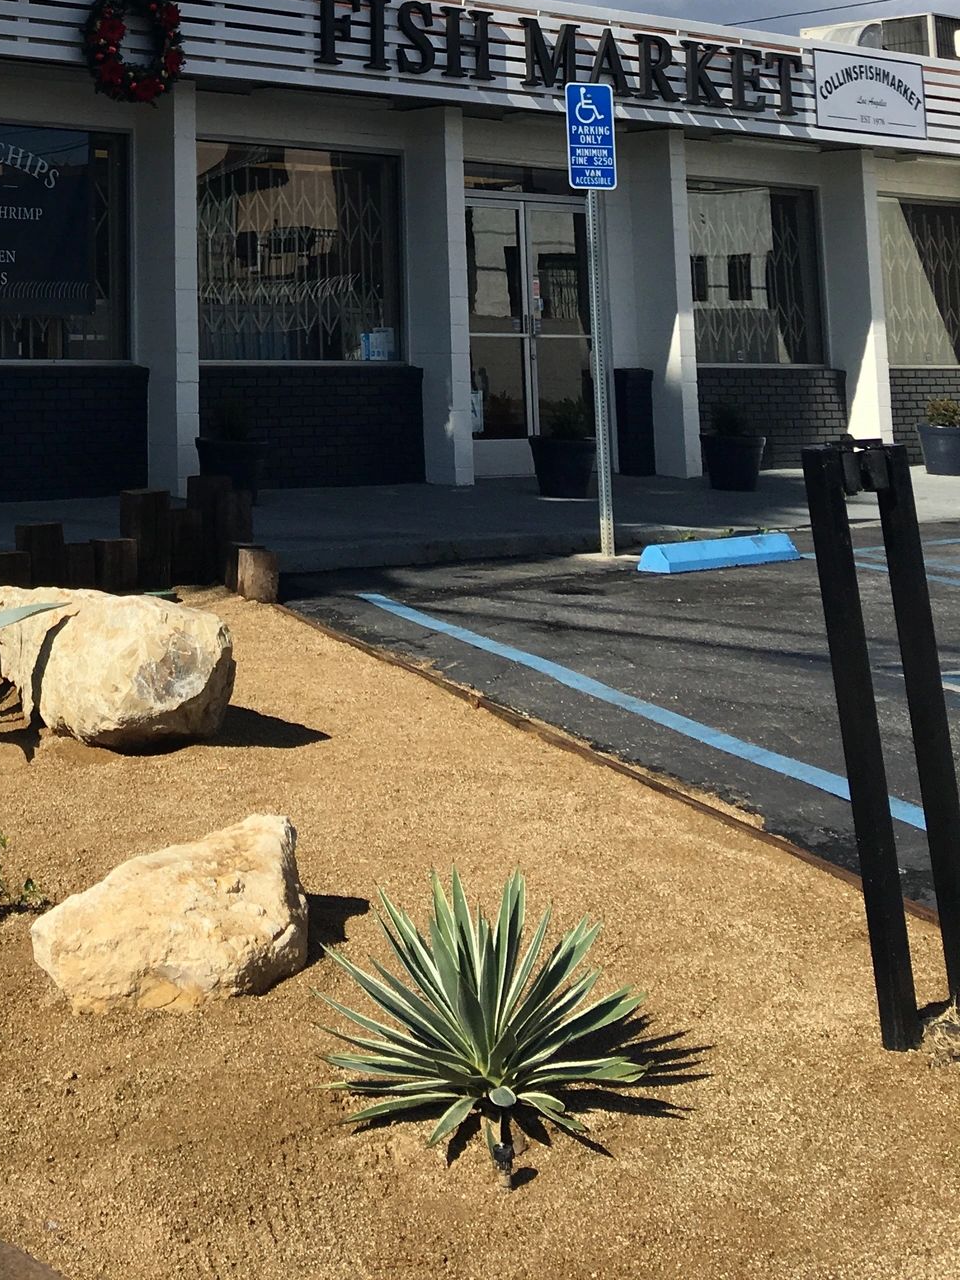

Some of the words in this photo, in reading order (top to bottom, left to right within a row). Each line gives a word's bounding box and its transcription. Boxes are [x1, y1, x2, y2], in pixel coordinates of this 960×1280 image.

[518, 17, 803, 116] MARKET
[820, 65, 922, 111] COLLINSFISHMARKET
[572, 125, 610, 135] PARKING
[580, 135, 602, 144] ONLY
[576, 148, 608, 157] MINIMUM
[572, 156, 588, 165] FINE
[593, 157, 613, 166] $250
[585, 169, 602, 177] VAN
[576, 177, 611, 185] ACCESSIBLE
